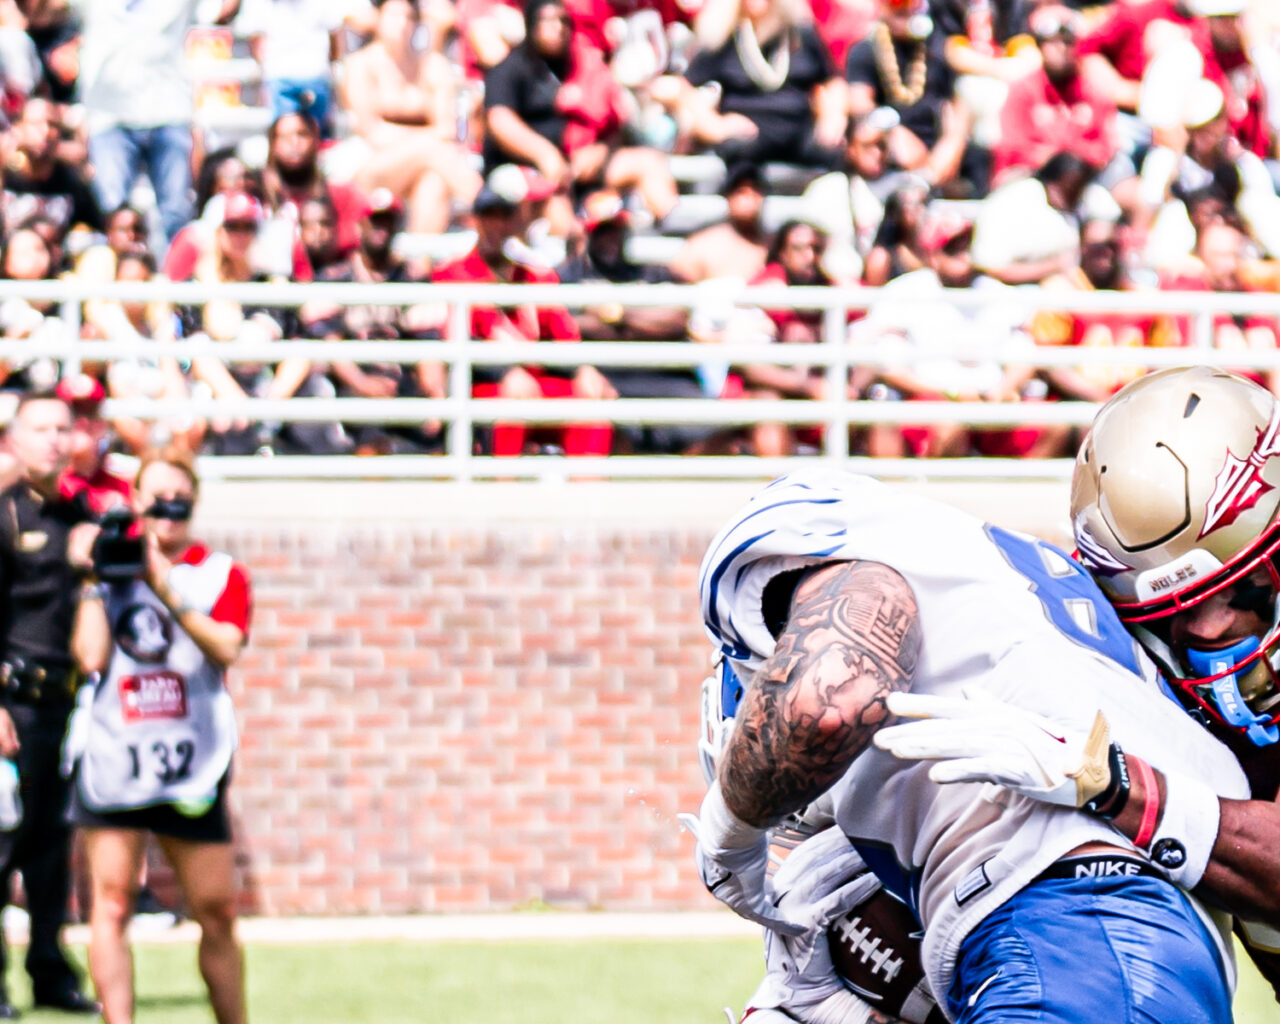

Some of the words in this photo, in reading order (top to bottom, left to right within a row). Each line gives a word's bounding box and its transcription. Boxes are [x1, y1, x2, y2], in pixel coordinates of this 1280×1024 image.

[1149, 563, 1197, 592] NOLES
[127, 740, 195, 785] 132
[1075, 860, 1141, 880] NIKE
